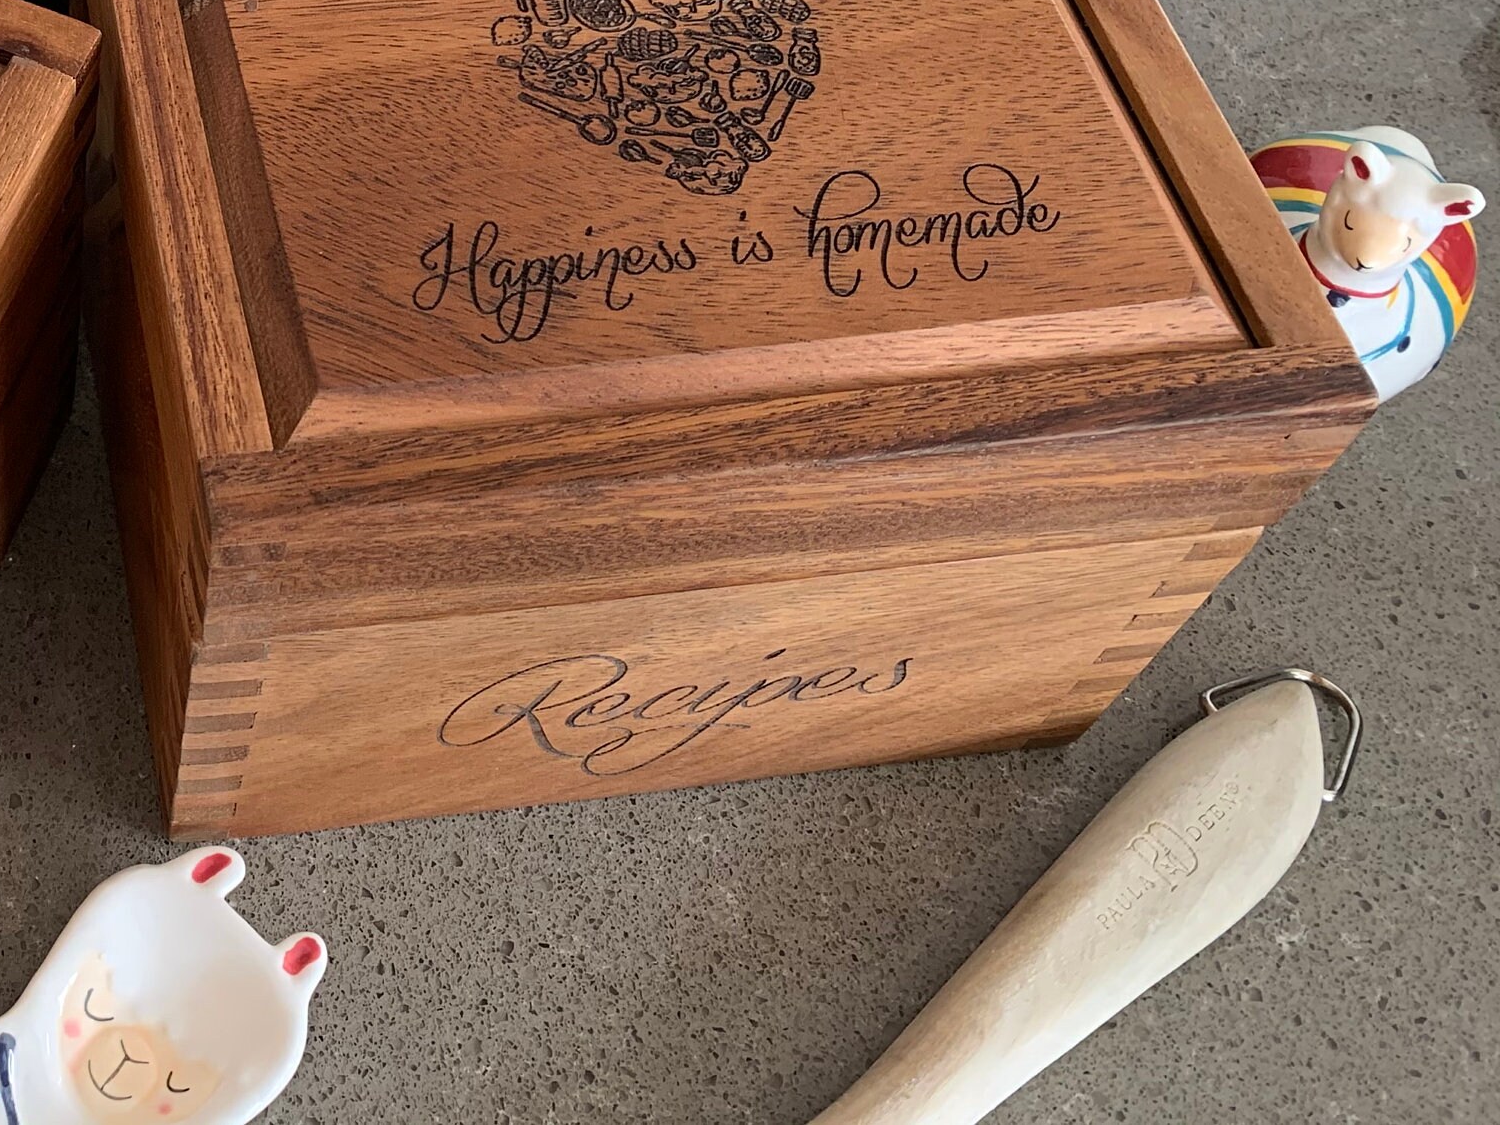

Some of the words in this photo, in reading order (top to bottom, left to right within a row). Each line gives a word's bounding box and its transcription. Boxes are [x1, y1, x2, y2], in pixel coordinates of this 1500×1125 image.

[411, 219, 700, 345] Happiness
[732, 210, 774, 263] is
[795, 163, 1061, 298] homemade
[437, 648, 913, 776] Recipes
[1097, 875, 1156, 930] PAULA
